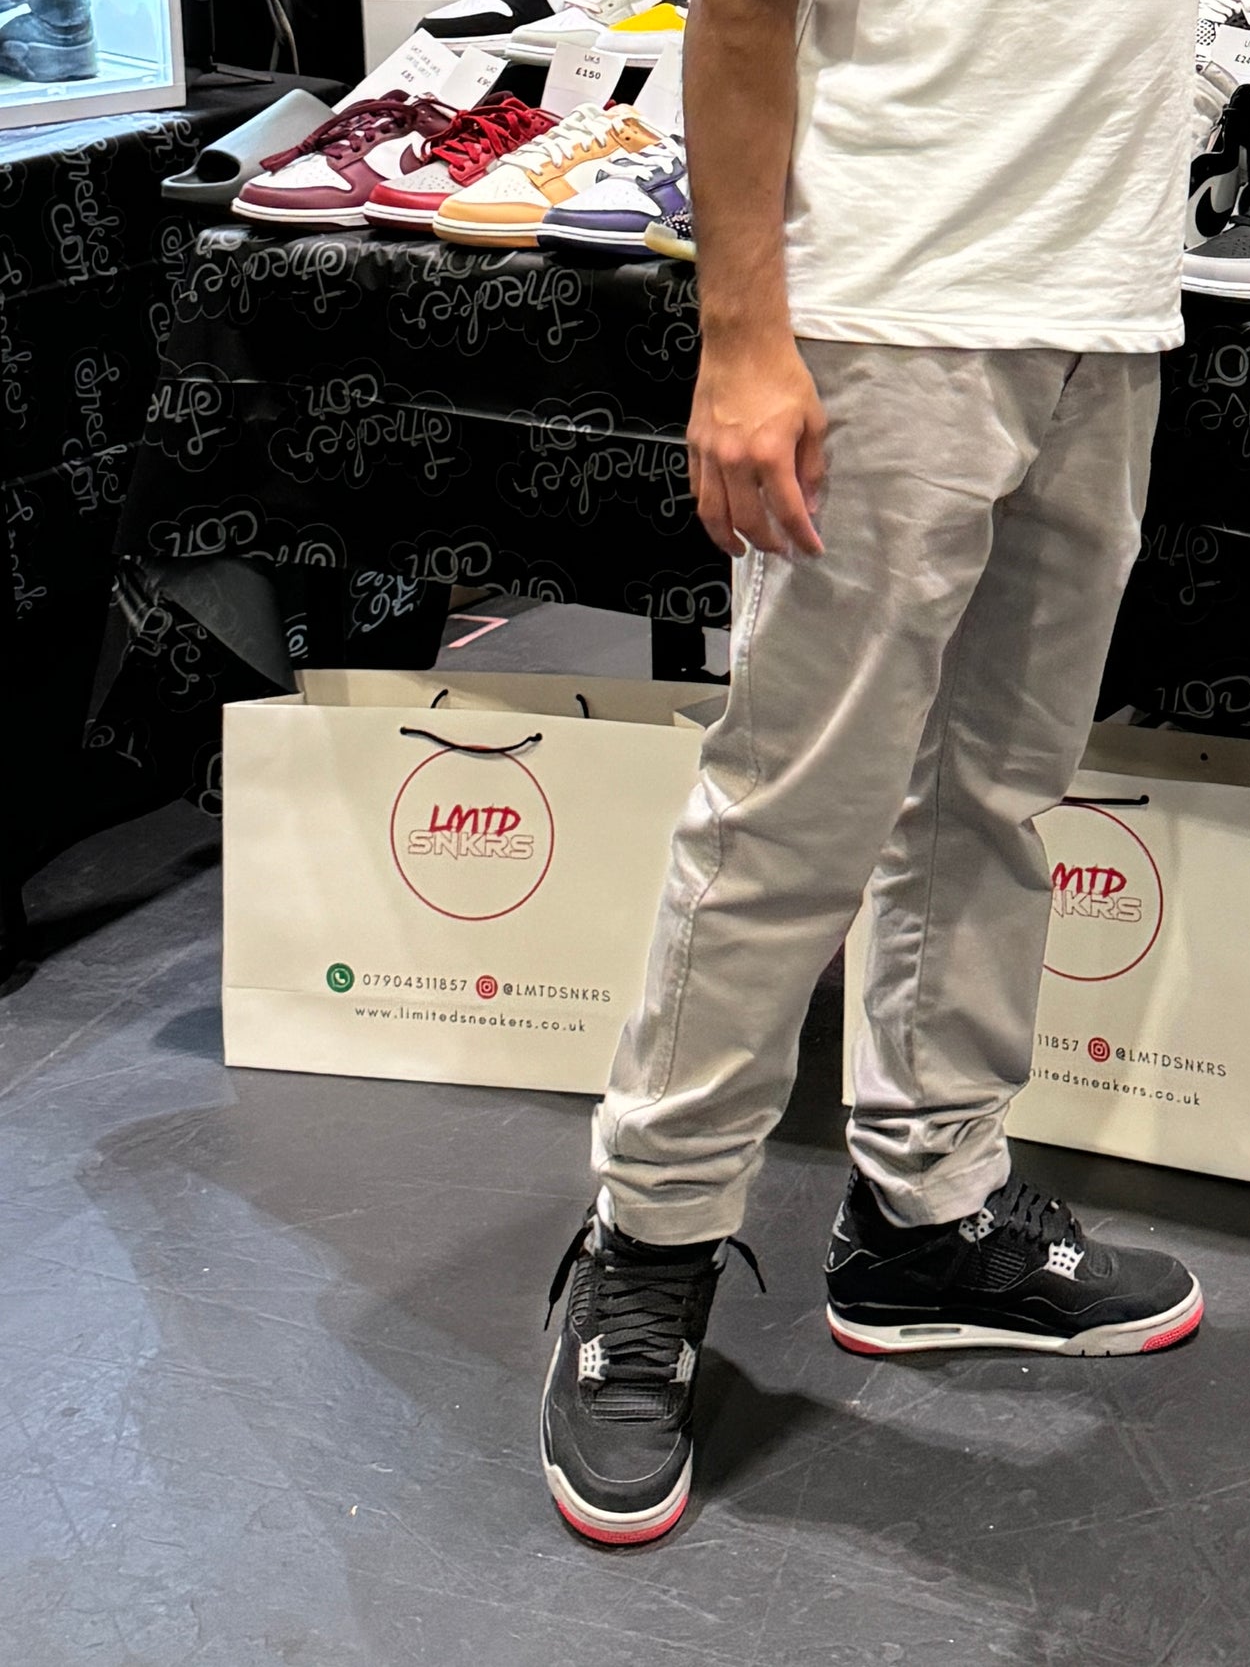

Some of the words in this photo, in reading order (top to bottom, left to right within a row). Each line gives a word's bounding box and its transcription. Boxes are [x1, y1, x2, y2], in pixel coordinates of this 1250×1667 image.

[575, 67, 602, 81] £150
[429, 802, 522, 837] LMTD
[407, 829, 535, 860] SNKRS
[1053, 861, 1128, 898] MTD
[502, 981, 612, 1004] @LMTDSNKRS
[354, 1004, 587, 1034] www.limitedsneakers.co.uk
[1115, 1045, 1228, 1078] @LMTDSNKRS
